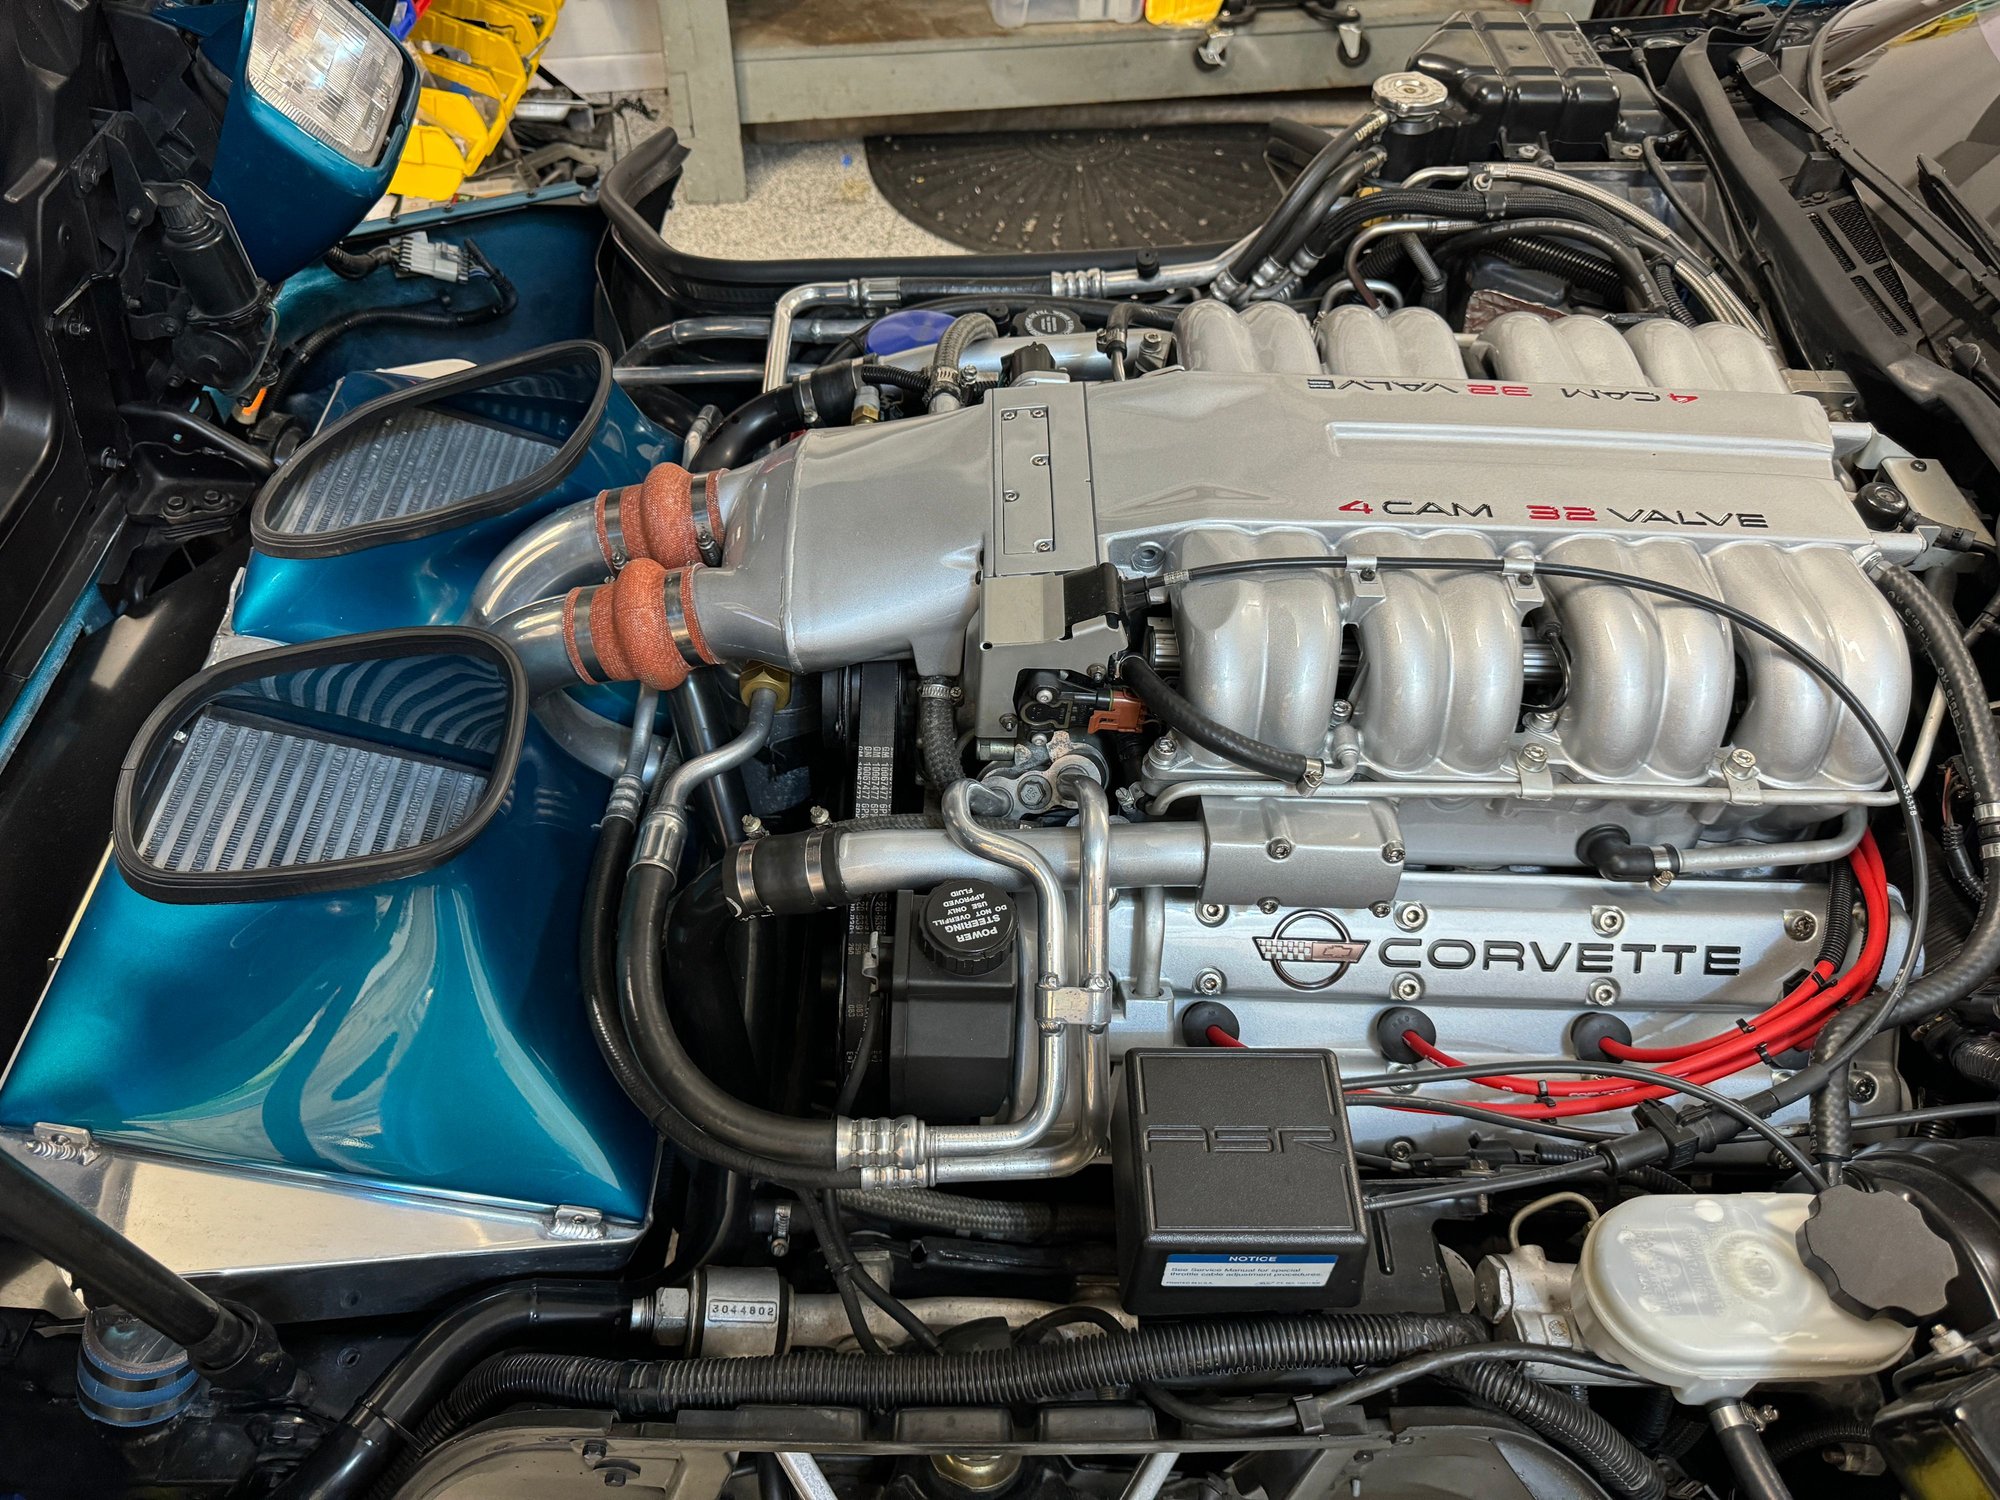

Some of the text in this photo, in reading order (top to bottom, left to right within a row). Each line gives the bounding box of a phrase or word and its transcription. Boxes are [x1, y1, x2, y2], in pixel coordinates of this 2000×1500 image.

[1307, 378, 1699, 405] 4 CAM 32 VALVE
[1338, 500, 1769, 529] 4 CAM 32 VALVE
[943, 893, 985, 908] APPROVED
[950, 887, 974, 897] FLUID
[932, 904, 1008, 927] DO NOT OVERFILL
[947, 901, 988, 916] USE ONLY
[944, 914, 1001, 933] STEERING
[956, 926, 998, 943] POWER
[1378, 938, 1742, 976] CORVETTE
[1143, 1124, 1344, 1154] ASR
[712, 1304, 774, 1316] 3044802
